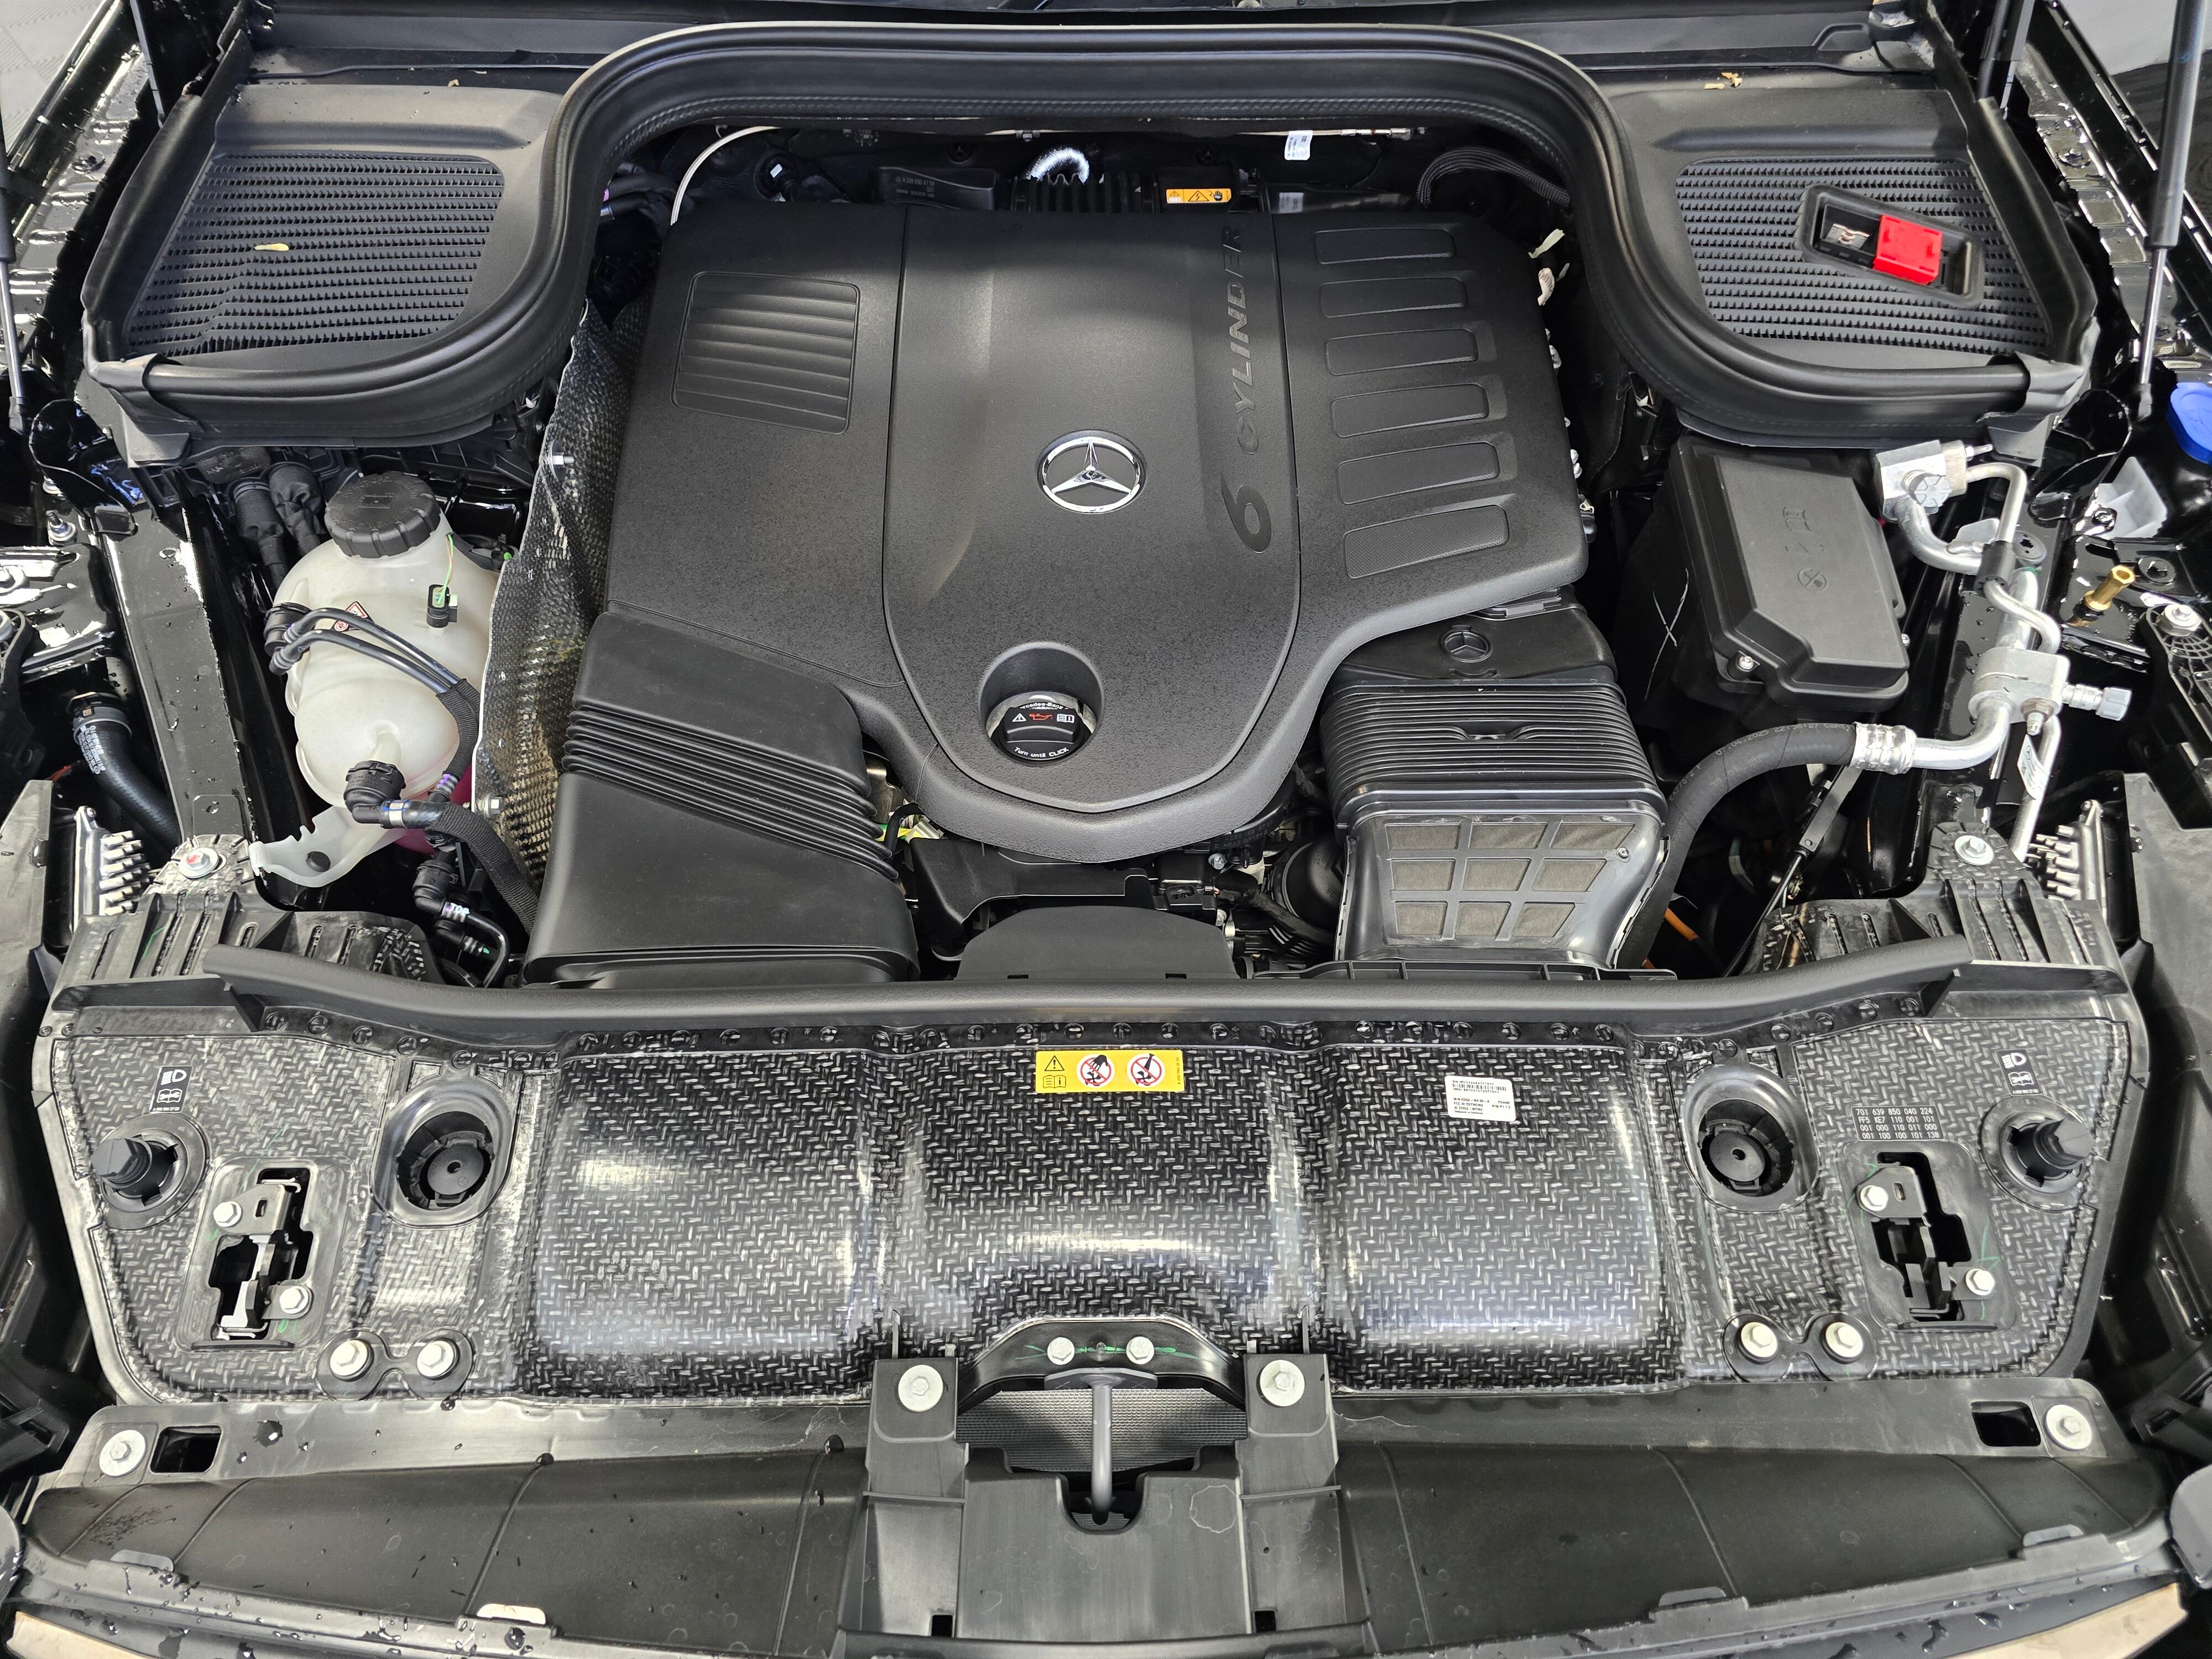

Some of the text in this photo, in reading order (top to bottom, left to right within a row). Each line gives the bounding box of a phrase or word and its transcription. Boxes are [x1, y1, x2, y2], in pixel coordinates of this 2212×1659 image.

[1220, 226, 1271, 553] 6 CYLINDER
[1014, 747, 1029, 756] Turn
[1048, 747, 1070, 757] CLICK
